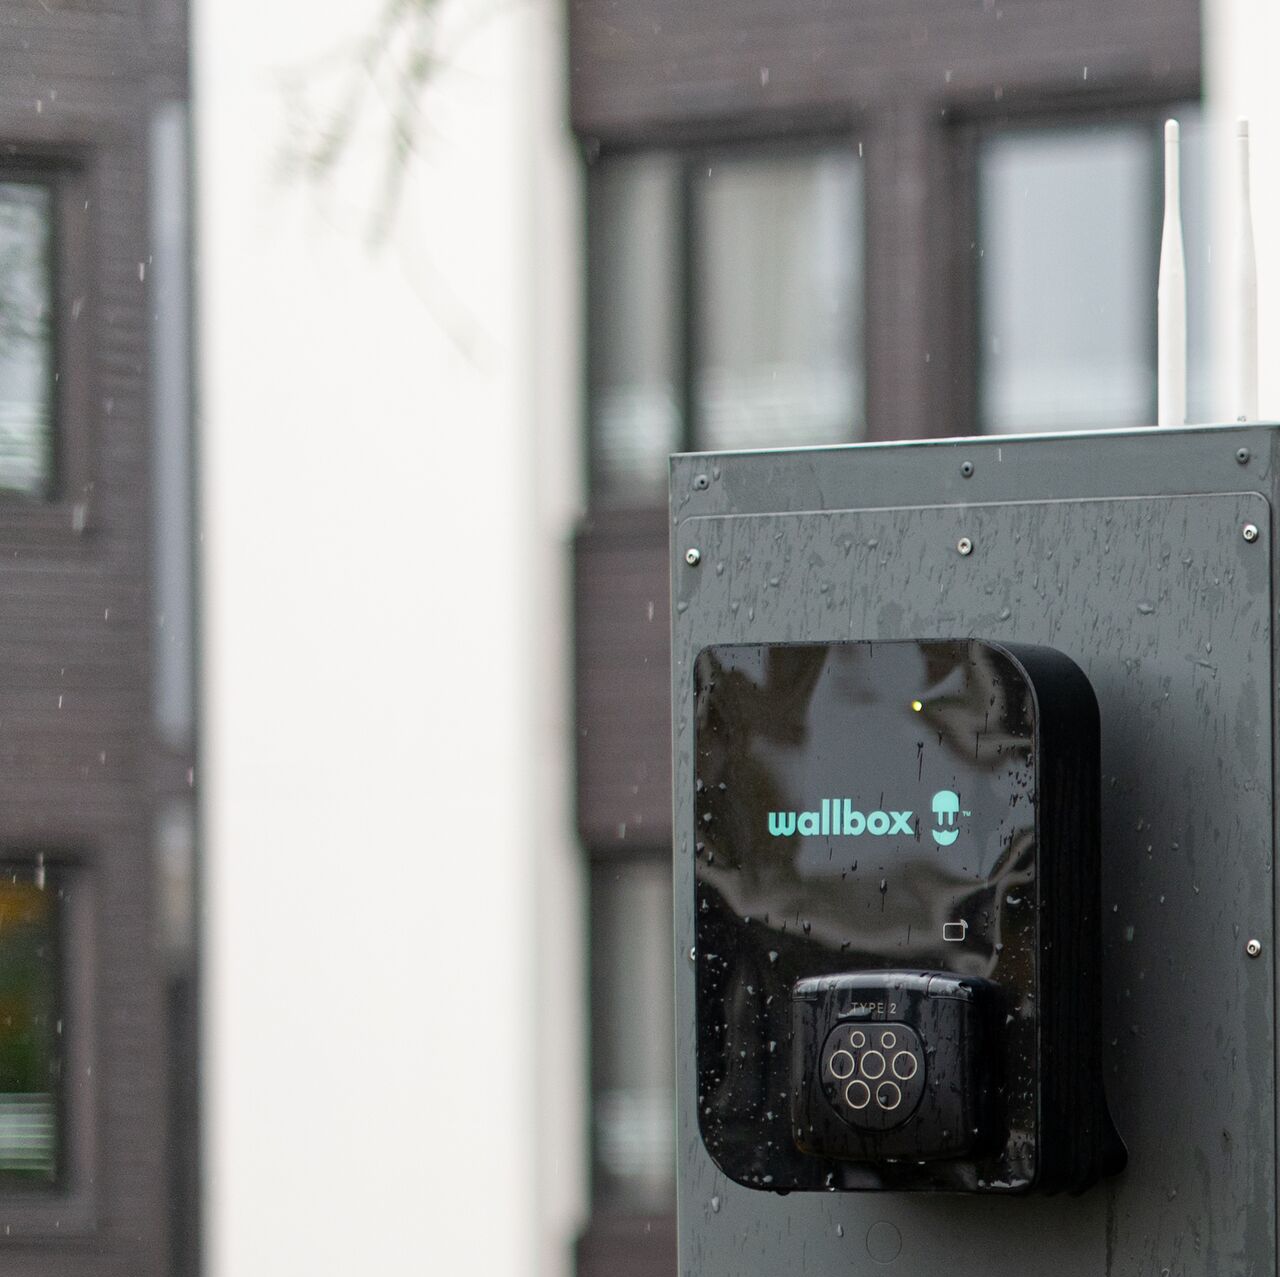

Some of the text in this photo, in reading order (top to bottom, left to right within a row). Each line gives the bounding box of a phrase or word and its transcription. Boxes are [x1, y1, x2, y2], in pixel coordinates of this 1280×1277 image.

[768, 798, 914, 837] wallbox
[851, 1002, 897, 1014] TYPE 2
